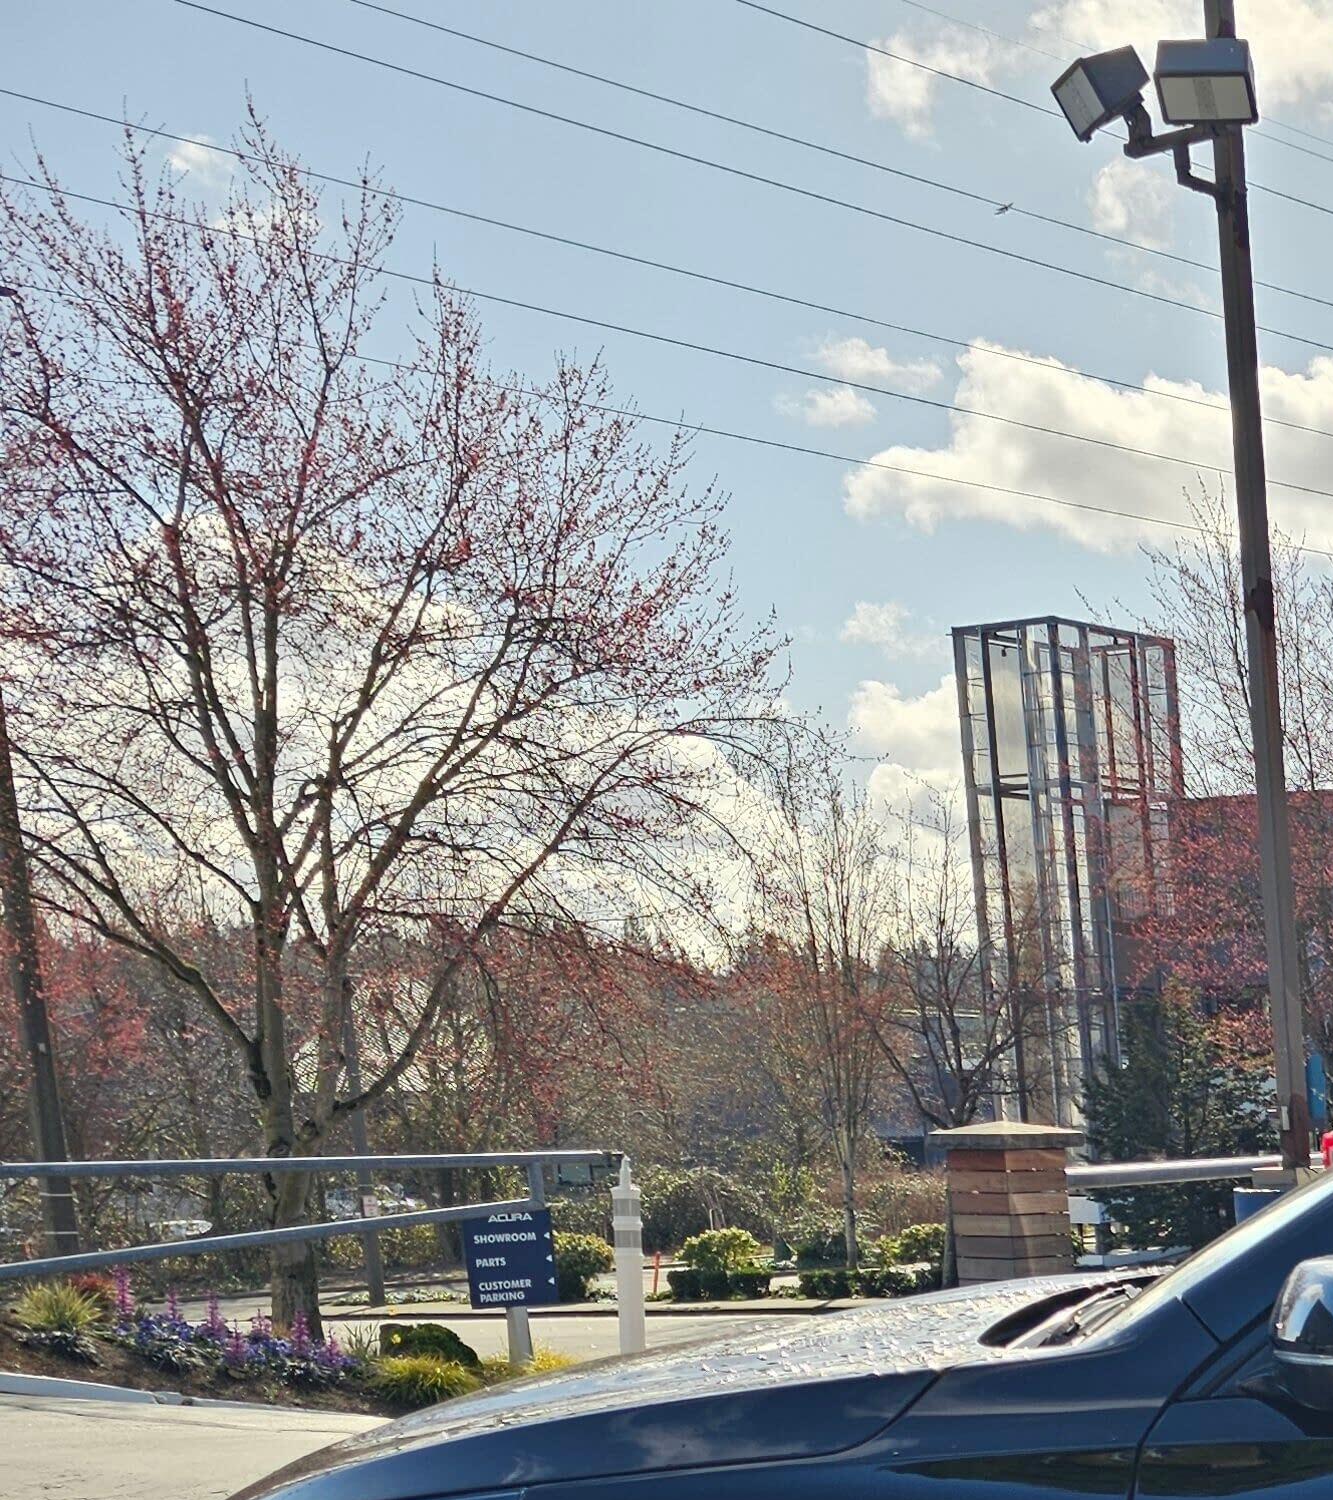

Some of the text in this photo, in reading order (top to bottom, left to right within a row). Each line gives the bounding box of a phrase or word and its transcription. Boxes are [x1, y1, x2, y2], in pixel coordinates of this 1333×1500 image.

[488, 1212, 533, 1223] ACURA
[473, 1231, 537, 1244] SHOWROOM
[475, 1256, 507, 1268] PARTS
[478, 1278, 532, 1292] CUSTOMER
[479, 1290, 526, 1303] PARKING
